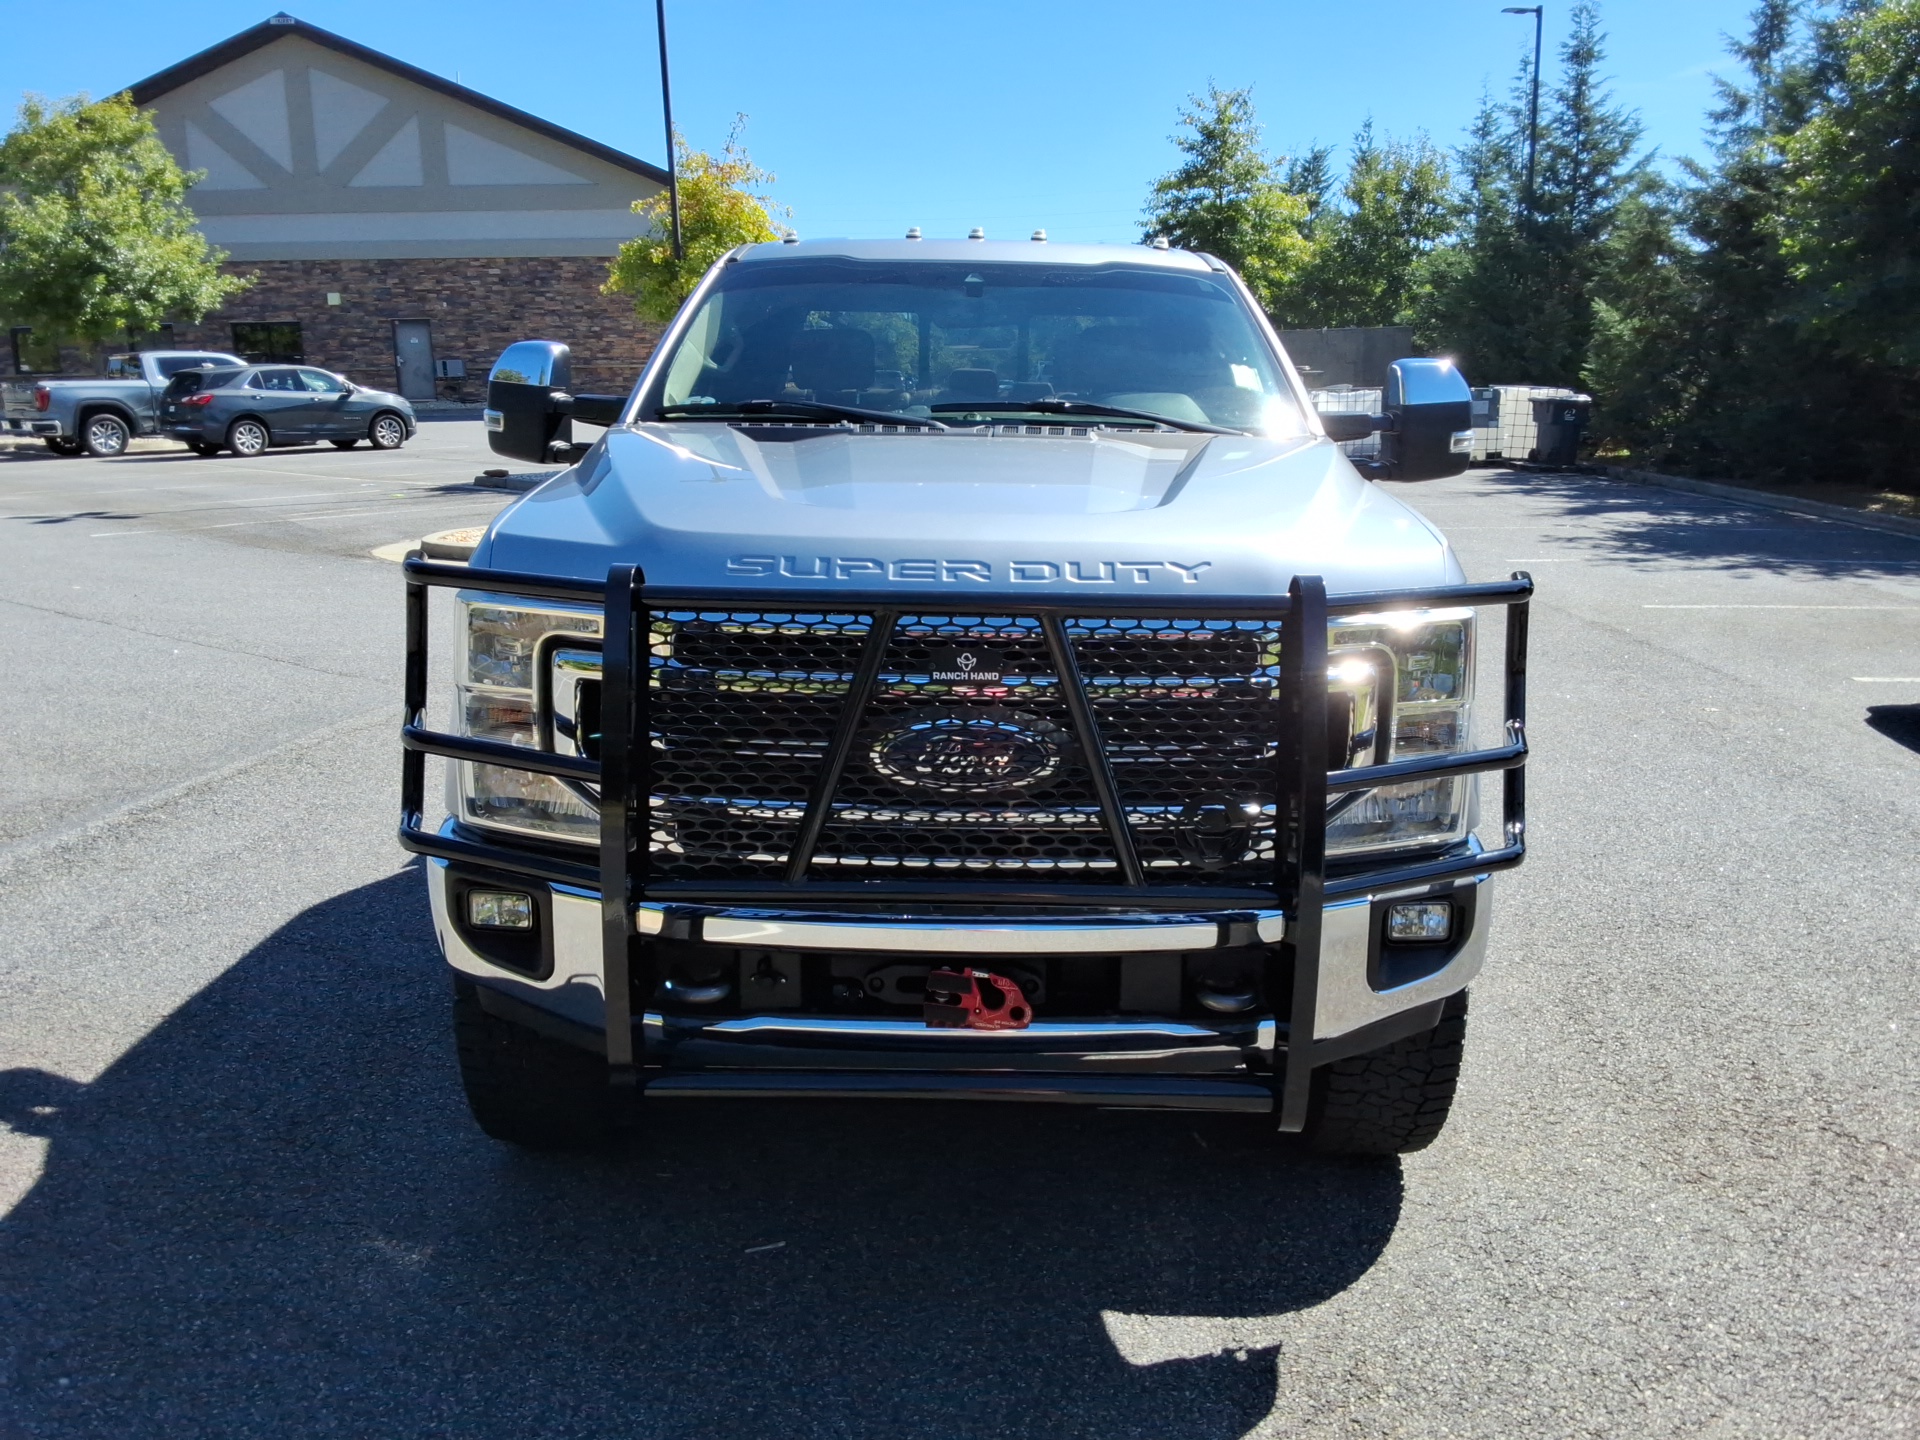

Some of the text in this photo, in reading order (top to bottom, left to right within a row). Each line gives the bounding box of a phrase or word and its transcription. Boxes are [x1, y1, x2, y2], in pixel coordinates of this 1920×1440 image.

[725, 554, 1212, 584] SUPER DUTY
[932, 671, 1000, 681] RANCH HAND
